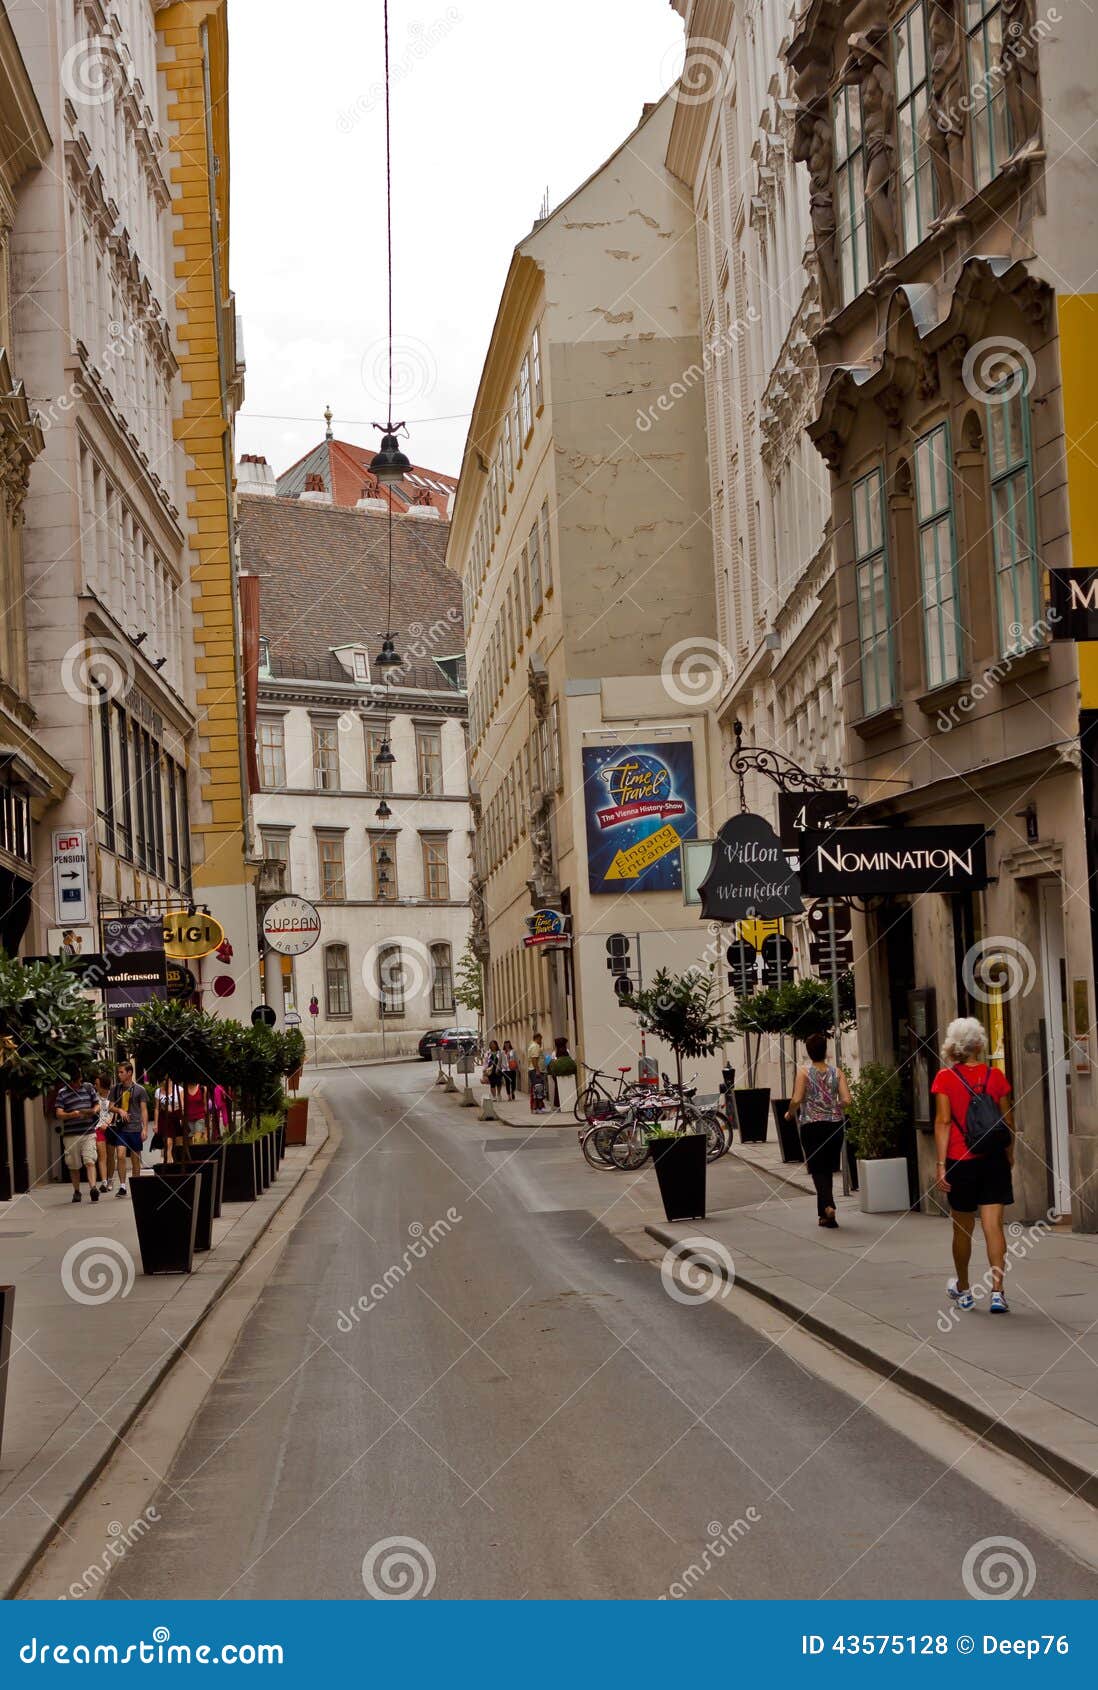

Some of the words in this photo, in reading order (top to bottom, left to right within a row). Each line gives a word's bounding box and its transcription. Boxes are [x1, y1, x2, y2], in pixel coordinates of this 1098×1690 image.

[601, 763, 653, 788] Time
[601, 813, 615, 823] The
[616, 808, 639, 818] Vienna
[640, 802, 683, 813] History-Show
[615, 828, 672, 868] Eingang
[618, 836, 678, 878] Entrance
[723, 841, 778, 863] Villon
[54, 854, 86, 864] PENSION
[817, 844, 973, 877] NOMINATION
[716, 883, 790, 903] Weinkeller
[274, 900, 308, 911] FINE
[264, 917, 319, 930] SUPPAN
[162, 926, 210, 943] GIGI
[275, 941, 309, 952] ARTS
[107, 972, 160, 982] wolfensson
